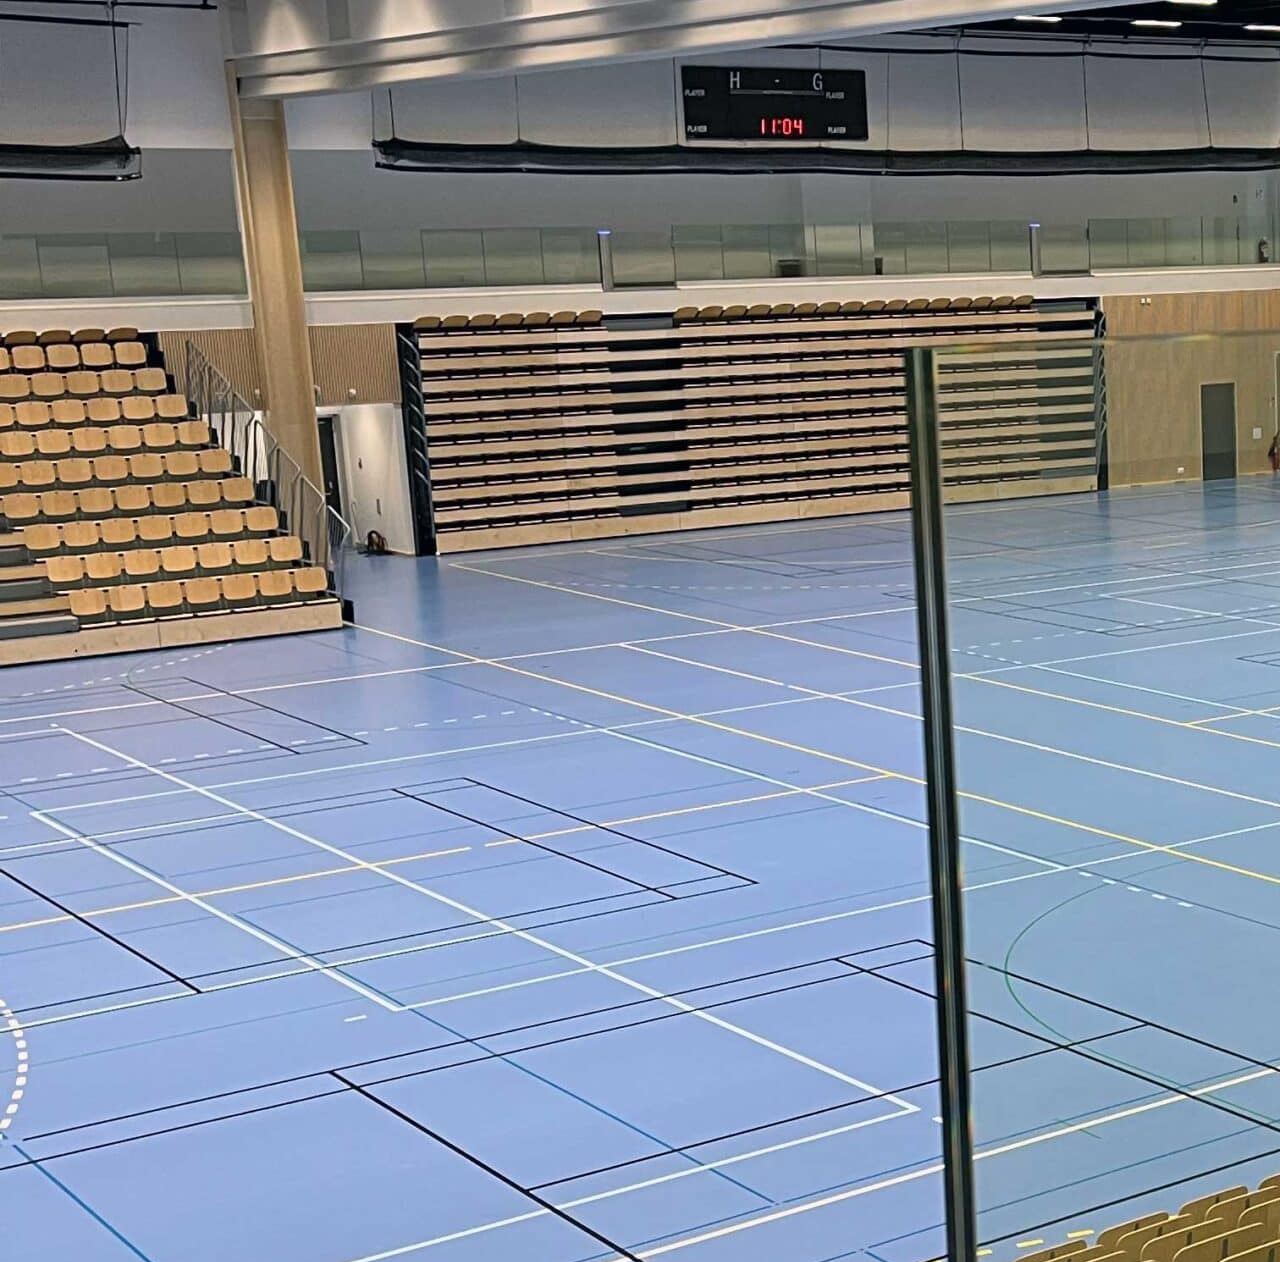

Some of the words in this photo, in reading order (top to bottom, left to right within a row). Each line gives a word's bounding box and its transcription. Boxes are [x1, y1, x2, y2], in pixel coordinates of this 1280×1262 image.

[730, 71, 740, 89] H
[812, 73, 823, 91] G
[761, 118, 803, 135] 11:04
